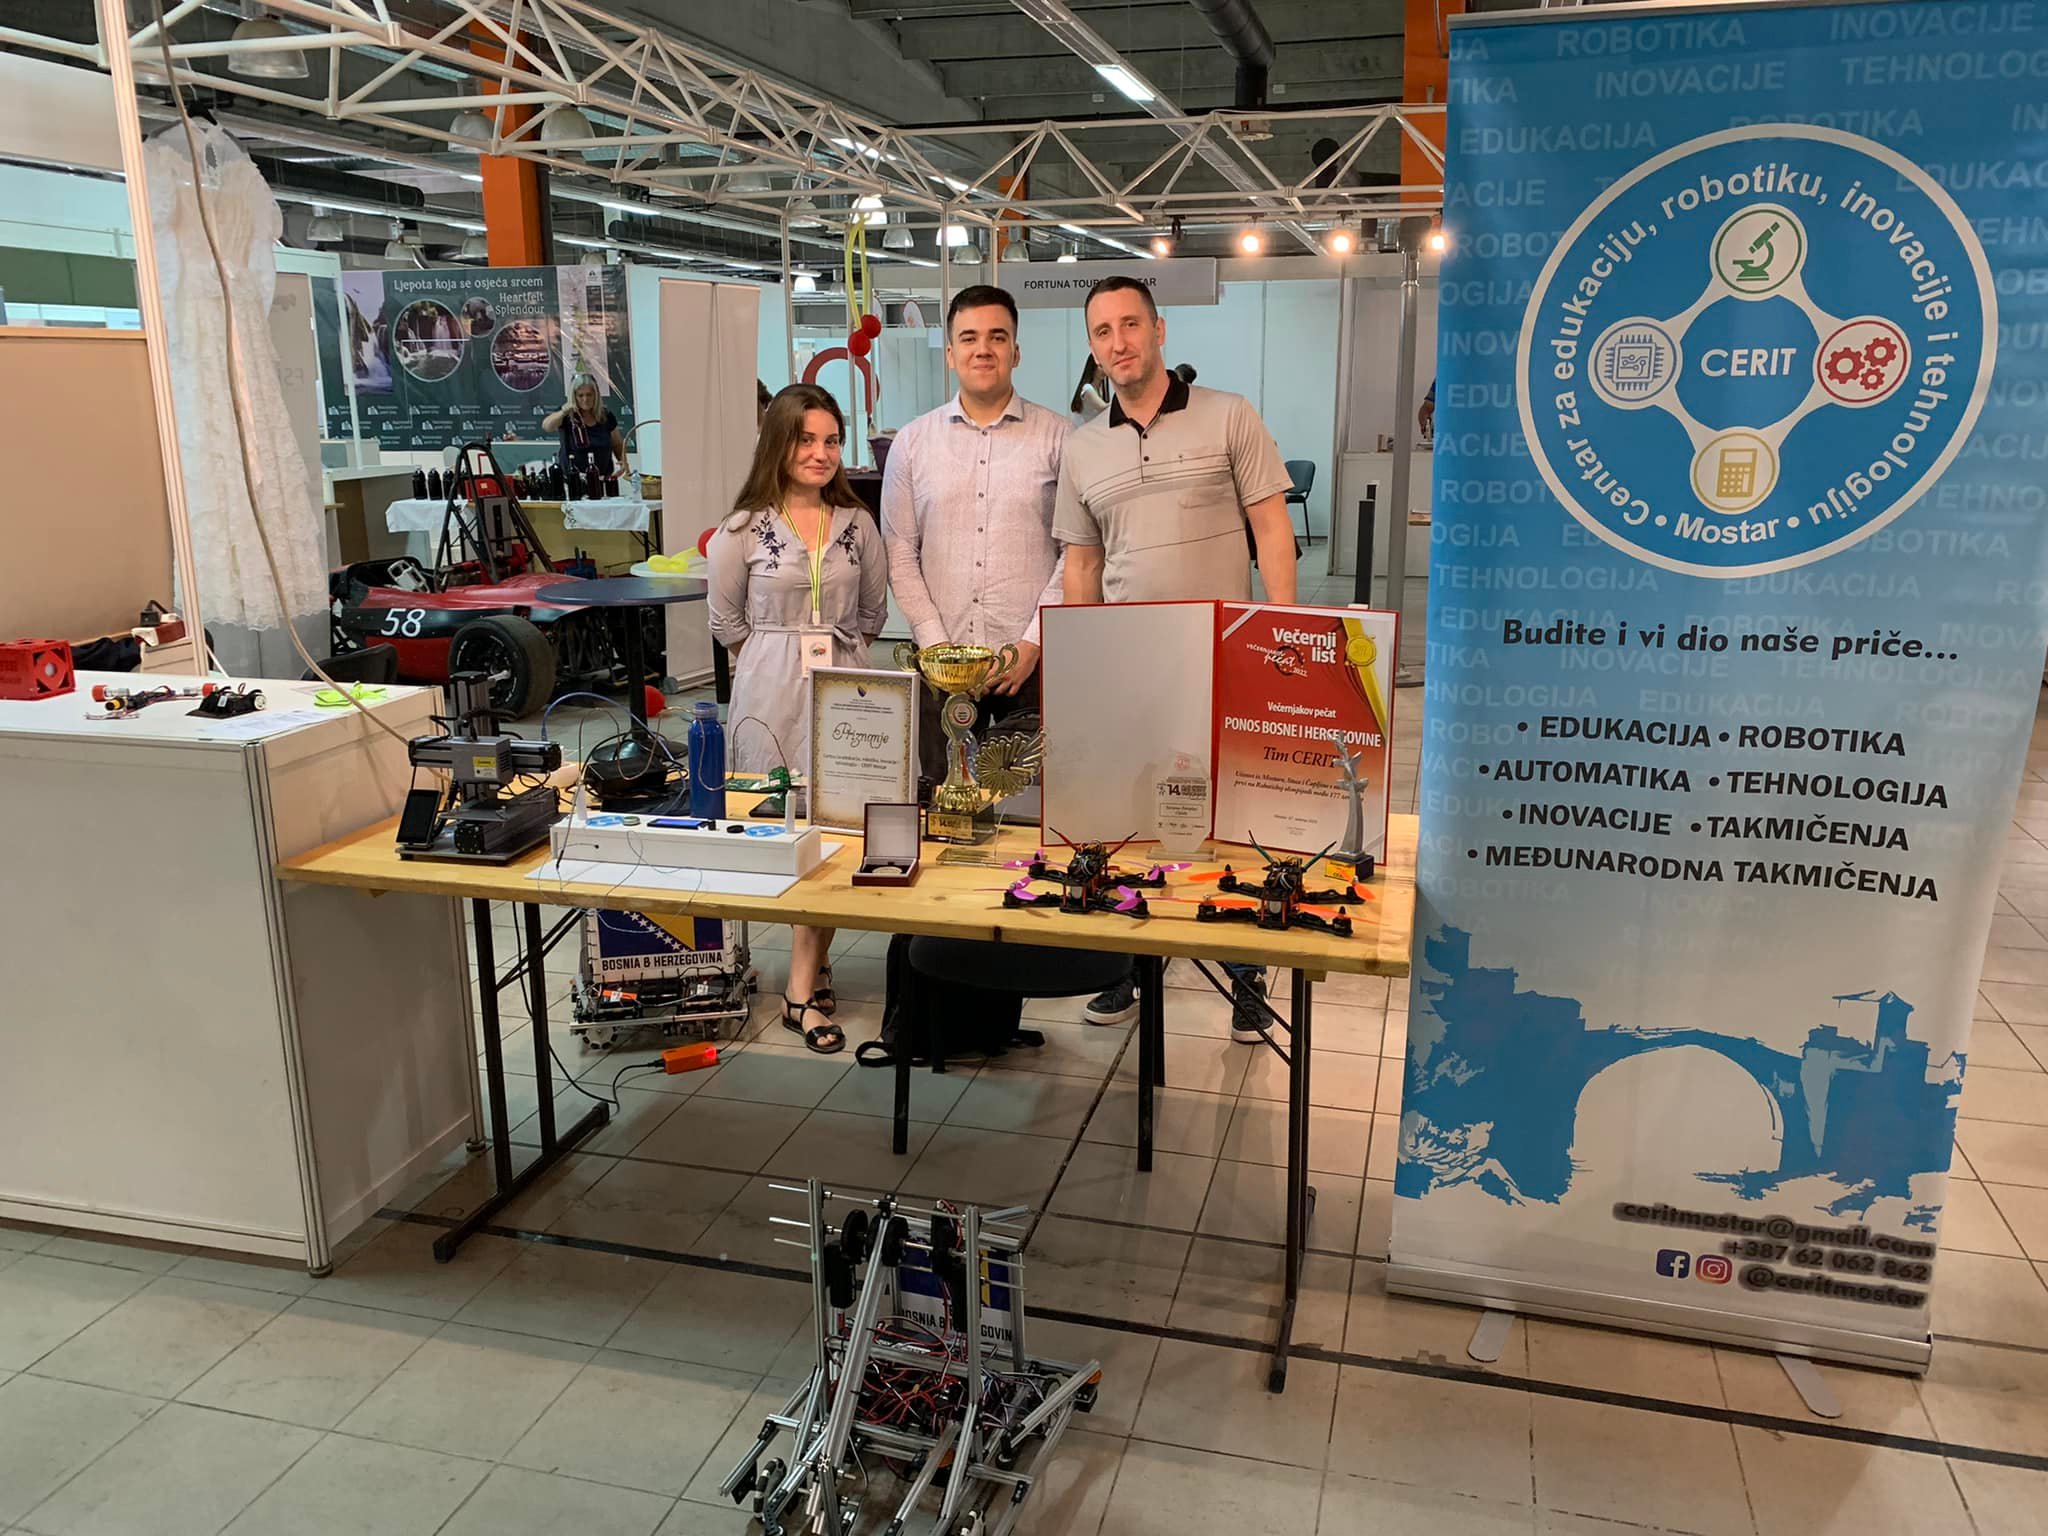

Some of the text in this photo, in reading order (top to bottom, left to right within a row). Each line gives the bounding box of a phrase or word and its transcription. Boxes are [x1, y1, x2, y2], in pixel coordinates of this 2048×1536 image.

[1830, 3, 2035, 41] INOVACIJE
[1557, 20, 1746, 57] ROBOTIKA
[1595, 61, 1786, 100] INOVACIJE
[1460, 121, 1657, 155] EDUKACIJA
[394, 277, 433, 291] Ljepota
[435, 278, 457, 291] koja
[460, 281, 472, 289] se
[511, 277, 544, 288] srcem
[1024, 279, 1071, 289] FORTUNA
[495, 304, 544, 317] Splendour
[1551, 163, 1960, 526] Centar za edukaciju, robotiku, inovacije i tehnologiju
[1701, 347, 1796, 377] CERIT
[1673, 512, 1780, 545] Mostar
[1434, 563, 1660, 592] TEHNOLOGIJA
[380, 608, 426, 638] 58
[1272, 627, 1337, 649] Večernji
[1502, 619, 1960, 661] Budite i vi dio naše priče...
[1312, 647, 1337, 664] list
[1267, 701, 1336, 719] Večernjakov pečat
[1225, 716, 1261, 733] PONOS
[1262, 721, 1297, 738] BOSNE
[1540, 715, 1711, 748] EDUKACIJA
[1738, 724, 1907, 756] ROBOTIKA
[1263, 745, 1289, 763] Tim
[1493, 759, 1692, 793] AUTOMATIKA
[1726, 771, 1949, 809] TEHNOLOGIJA
[1518, 803, 1910, 851] INOVACIJE TAKMIČENJA
[1484, 845, 1939, 902] MEĐUNARODNA TAKMIČENJA
[602, 956, 641, 971] BOSNIA
[653, 952, 723, 968] HERZEGOVINA
